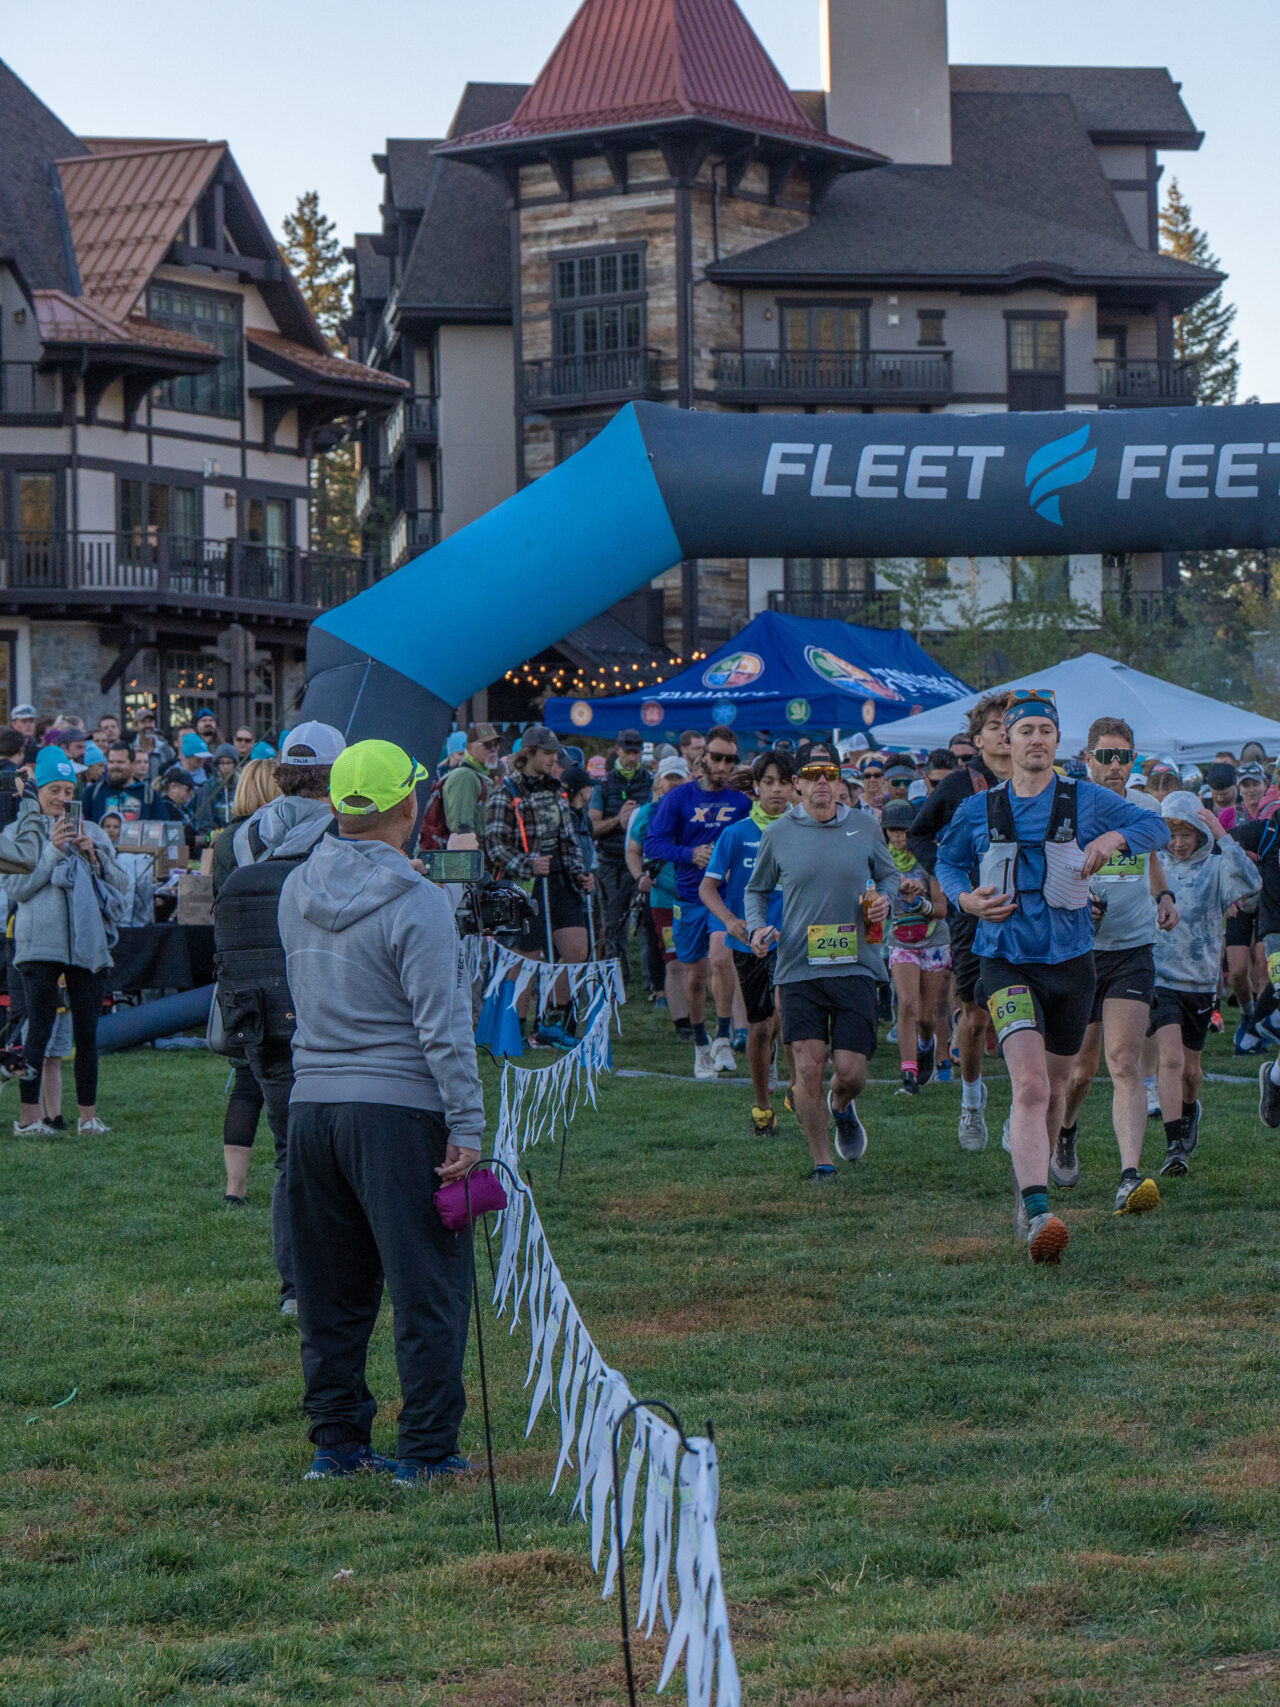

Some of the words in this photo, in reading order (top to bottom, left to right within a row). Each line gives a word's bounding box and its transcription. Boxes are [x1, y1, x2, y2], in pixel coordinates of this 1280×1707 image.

[761, 442, 1006, 500] FLEET
[1106, 854, 1138, 867] 129
[816, 937, 849, 950] 246
[996, 1001, 1017, 1019] 66
